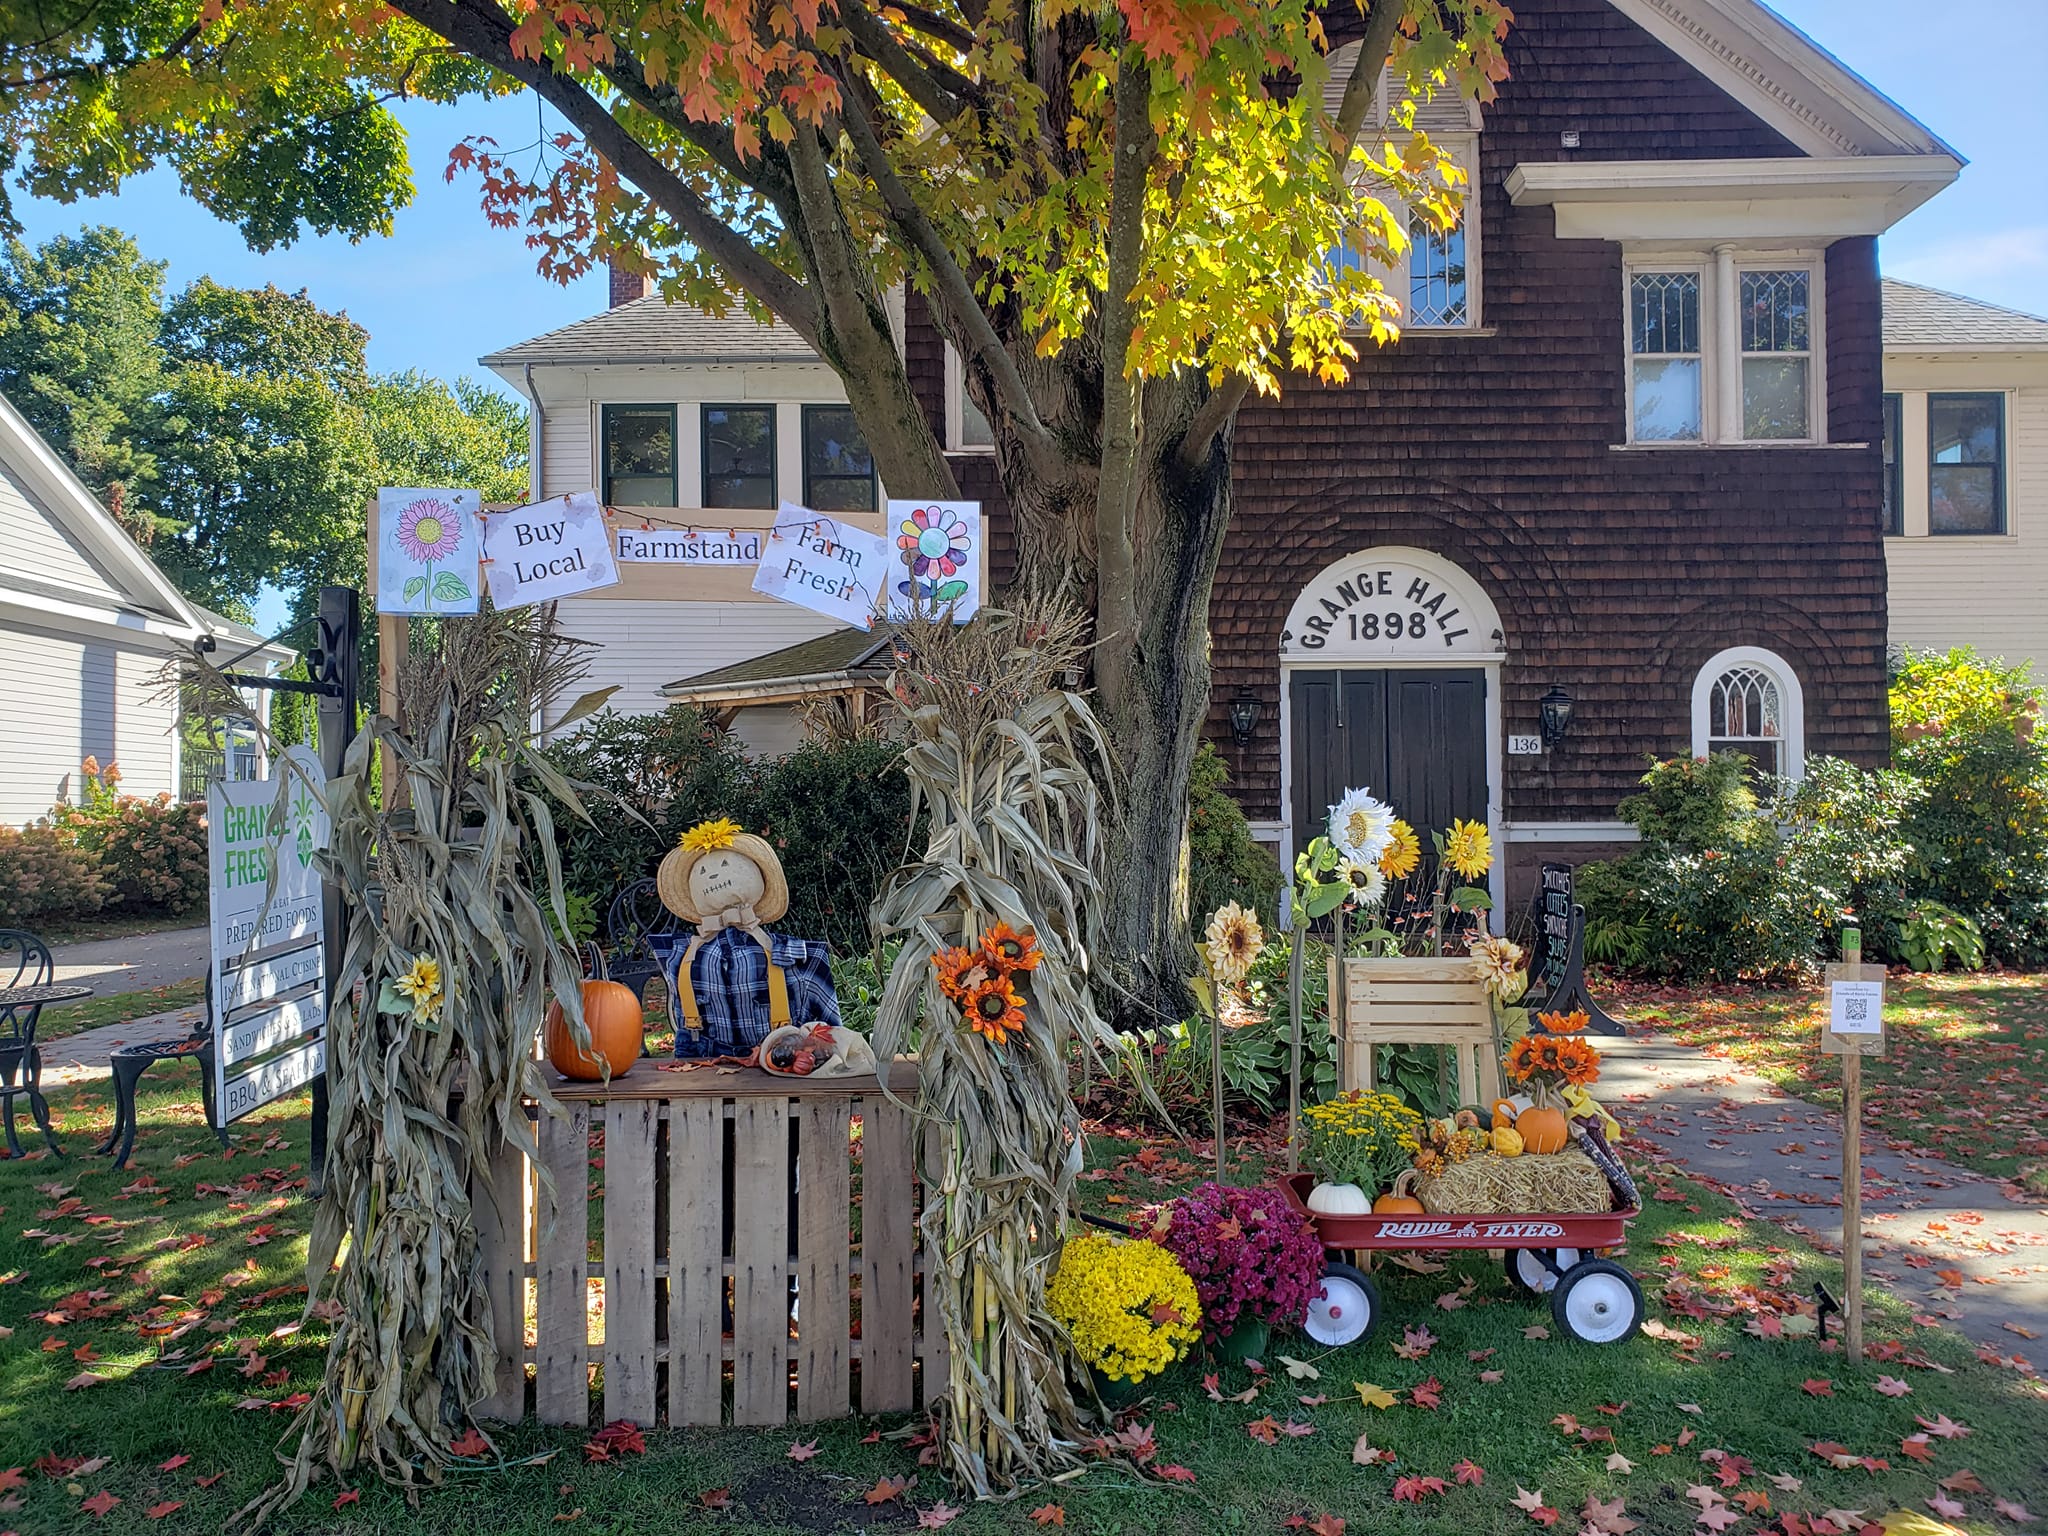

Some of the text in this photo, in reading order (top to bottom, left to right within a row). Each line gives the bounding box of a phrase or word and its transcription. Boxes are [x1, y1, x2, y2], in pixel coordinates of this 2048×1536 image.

[513, 521, 566, 547] Buy
[618, 536, 761, 560] Farmstand
[796, 525, 862, 569] Farm
[513, 548, 587, 584] Local
[782, 557, 853, 602] Fresh
[1300, 571, 1470, 650] GRANGE HALL
[1348, 612, 1427, 641] 1898
[1512, 737, 1539, 751] 136
[224, 846, 269, 889] FRES
[279, 896, 290, 909] EAT
[226, 905, 317, 945] PREPRED FOODS
[291, 955, 321, 976] CUISINE
[227, 1020, 282, 1055] SANDWICHES
[284, 1016, 290, 1030] &
[230, 1052, 323, 1113] BBQ & SEAFOOD
[1374, 1221, 1564, 1238] RADIO FLYER
